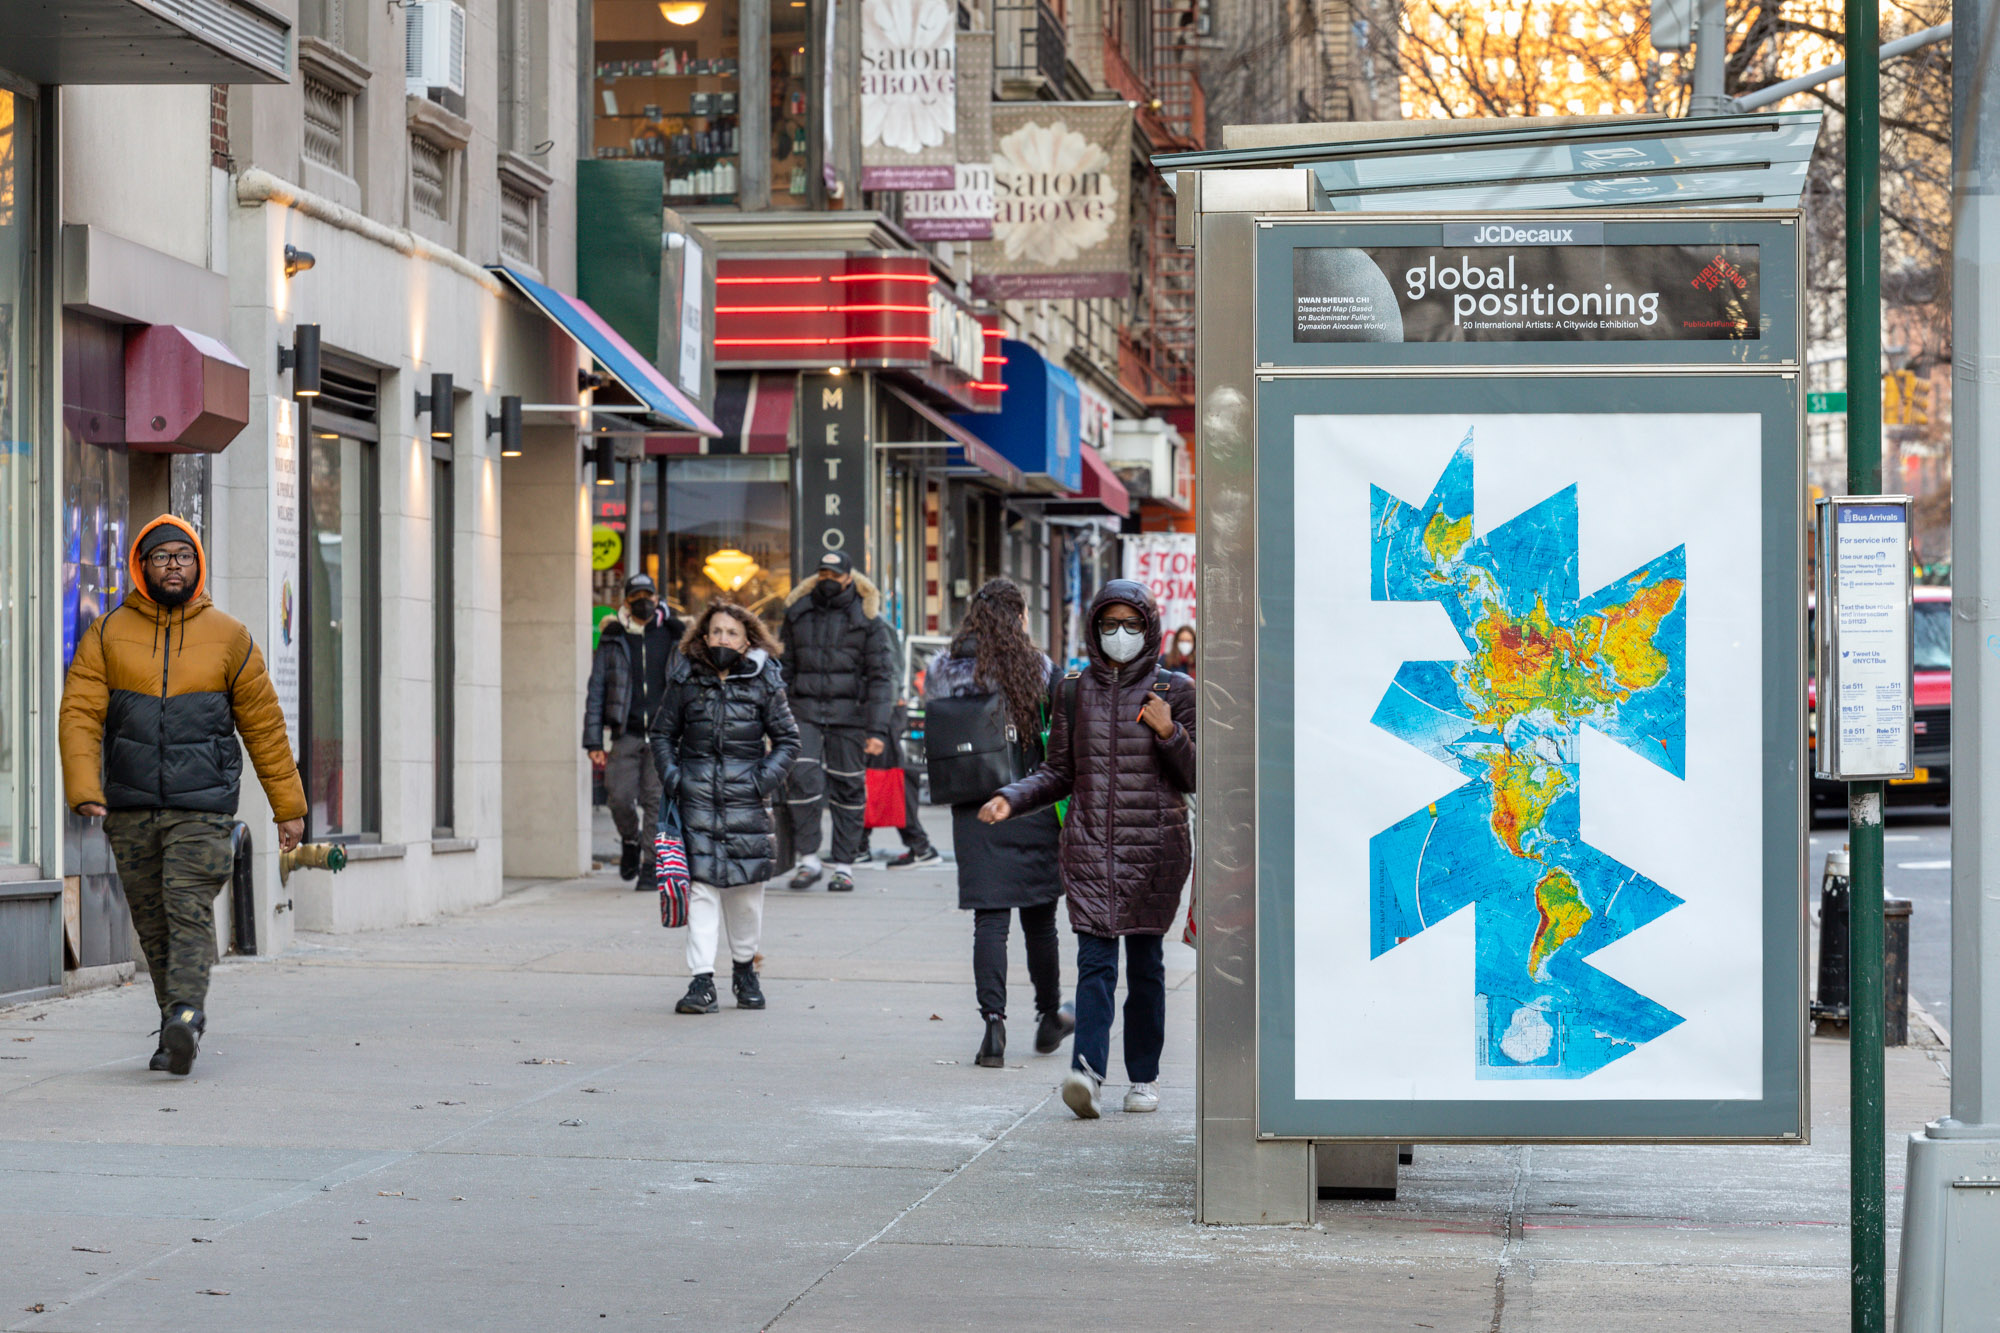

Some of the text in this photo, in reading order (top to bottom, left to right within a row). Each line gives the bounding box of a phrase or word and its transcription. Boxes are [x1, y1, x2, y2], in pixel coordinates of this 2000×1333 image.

[1474, 226, 1573, 244] JCDecaux
[1406, 255, 1515, 300] global
[1691, 255, 1747, 292] PUBLIC ART FUND
[1348, 306, 1372, 314] (Based
[1454, 283, 1660, 326] positioning
[1298, 323, 1330, 332] Dymaxion
[1364, 322, 1386, 330] World)
[1463, 321, 1473, 329] 20
[1474, 321, 1524, 329] International
[1526, 321, 1554, 329] Artists:
[1563, 320, 1598, 330] Citywide
[1600, 320, 1638, 328] Exhibition
[822, 386, 845, 550] METRO
